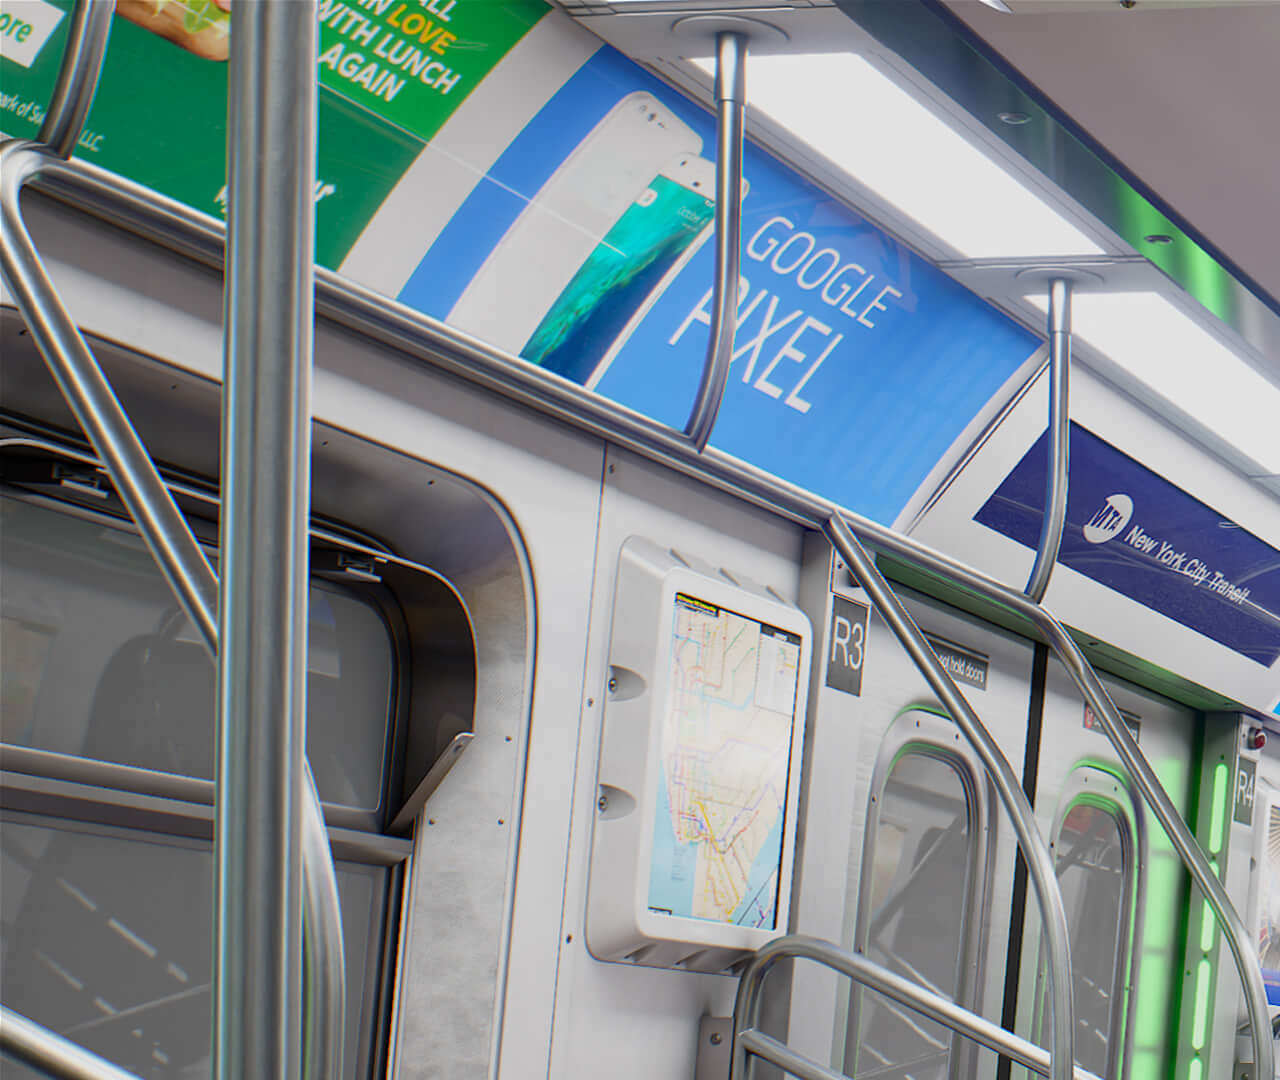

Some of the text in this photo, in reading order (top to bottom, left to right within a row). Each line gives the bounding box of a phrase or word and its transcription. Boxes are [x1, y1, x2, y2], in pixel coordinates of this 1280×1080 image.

[318, 0, 462, 95] WITH LUNCH
[386, 4, 457, 56] LOVE
[317, 42, 407, 102] AGAIN
[746, 216, 903, 329] GOOGLE
[668, 275, 844, 414] PIXEL
[1124, 525, 1251, 605] New York City Transit
[831, 616, 865, 670] R3
[1237, 769, 1254, 808] R4
